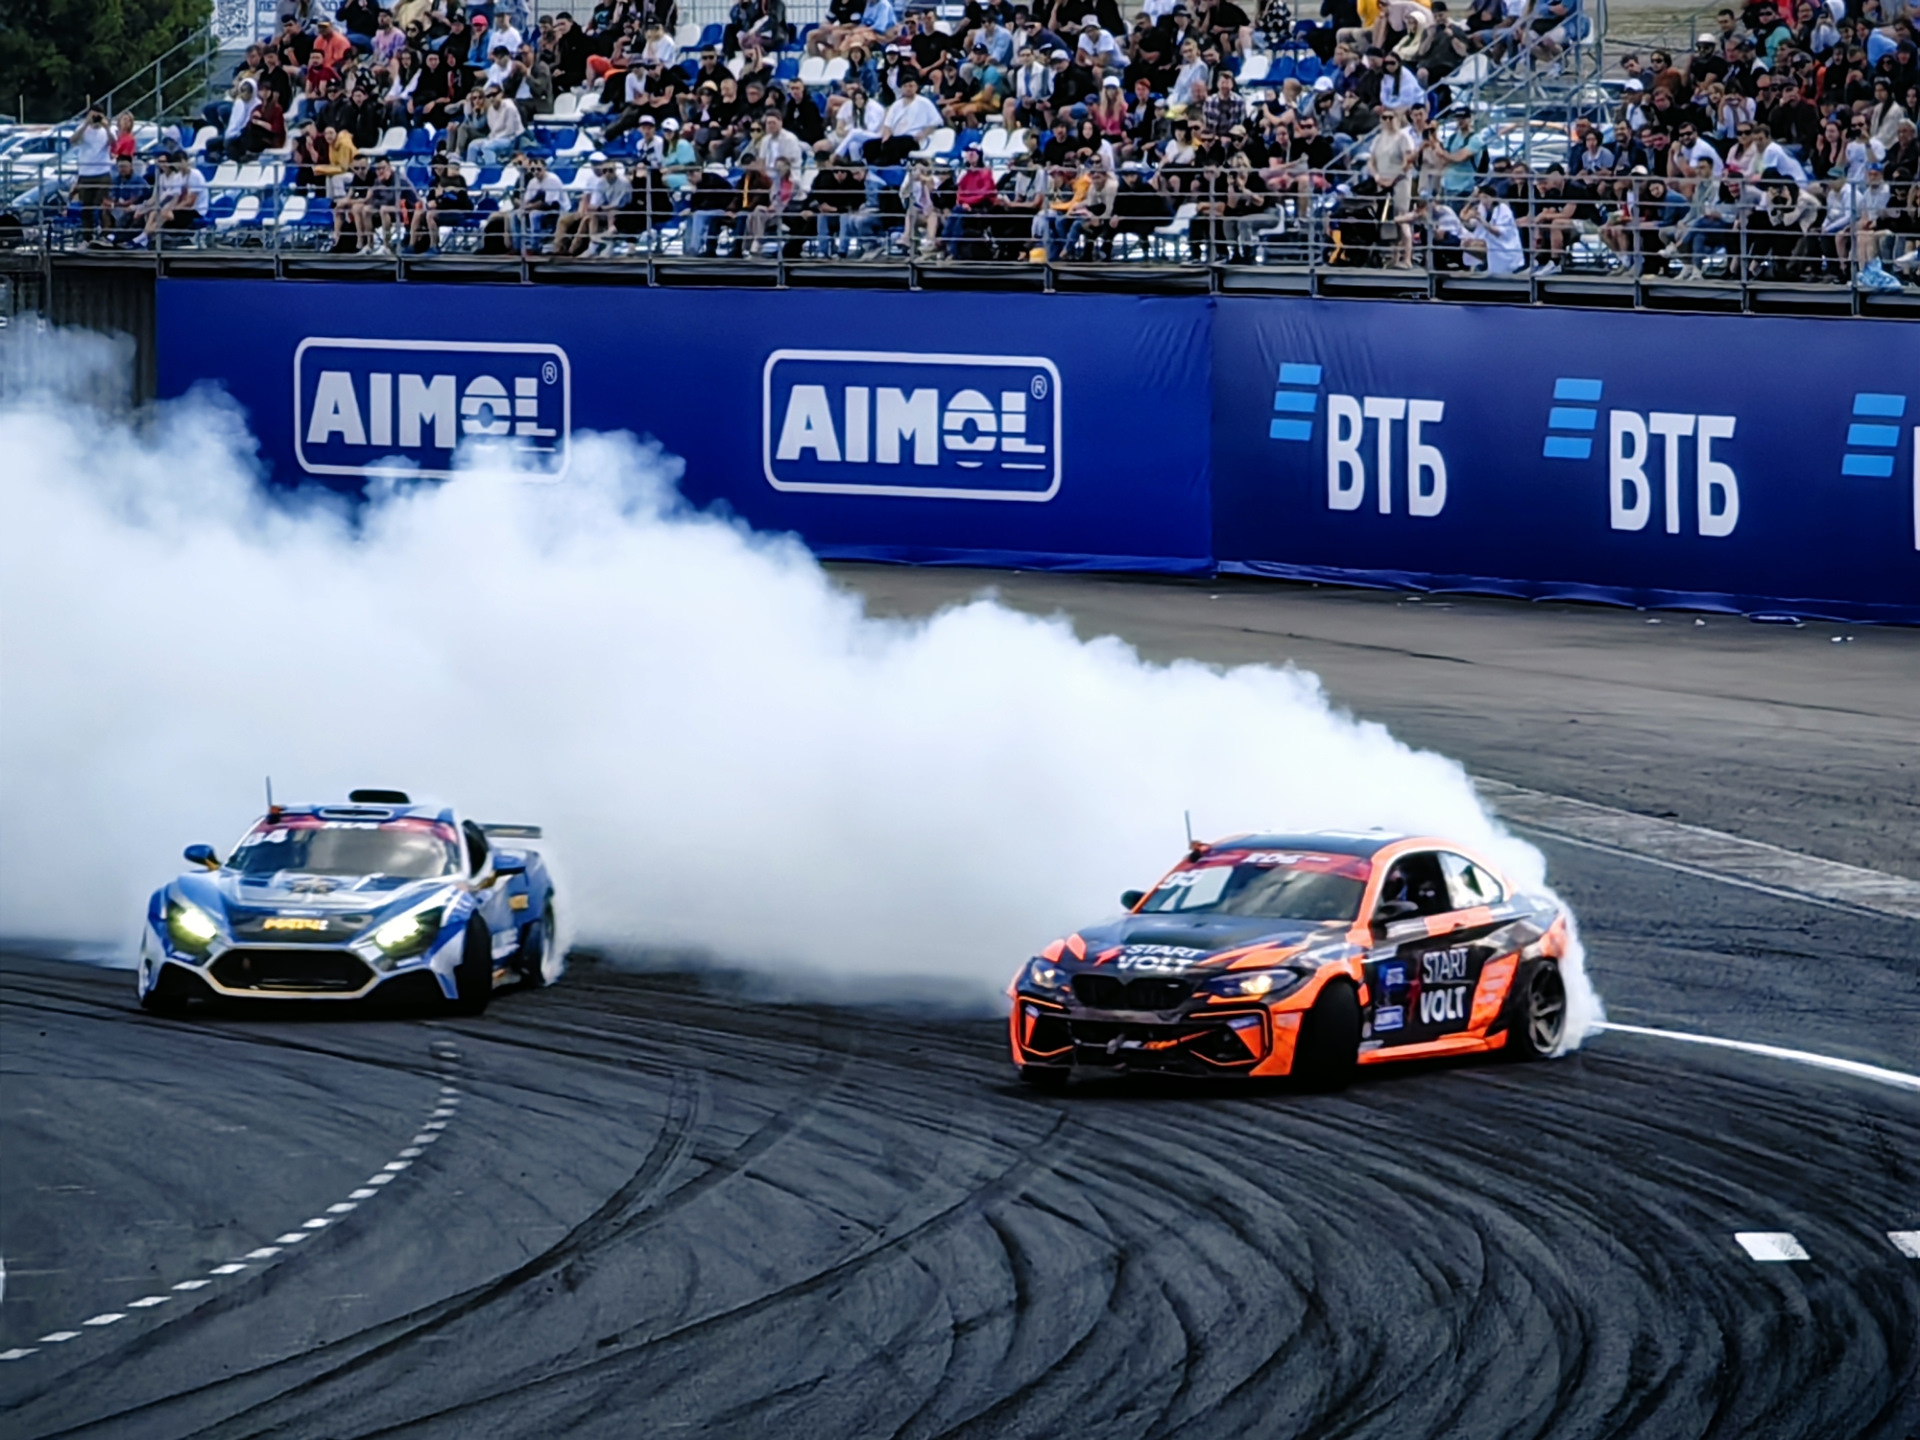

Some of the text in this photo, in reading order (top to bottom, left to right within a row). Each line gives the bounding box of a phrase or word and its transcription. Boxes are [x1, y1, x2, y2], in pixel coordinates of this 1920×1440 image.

[1327, 394, 1447, 517] ВТБ
[1609, 409, 1740, 538] ВТБ
[1117, 955, 1194, 973] VOLT
[1125, 944, 1206, 958] START
[1422, 949, 1469, 984] START
[1420, 986, 1467, 1025] VOLT
